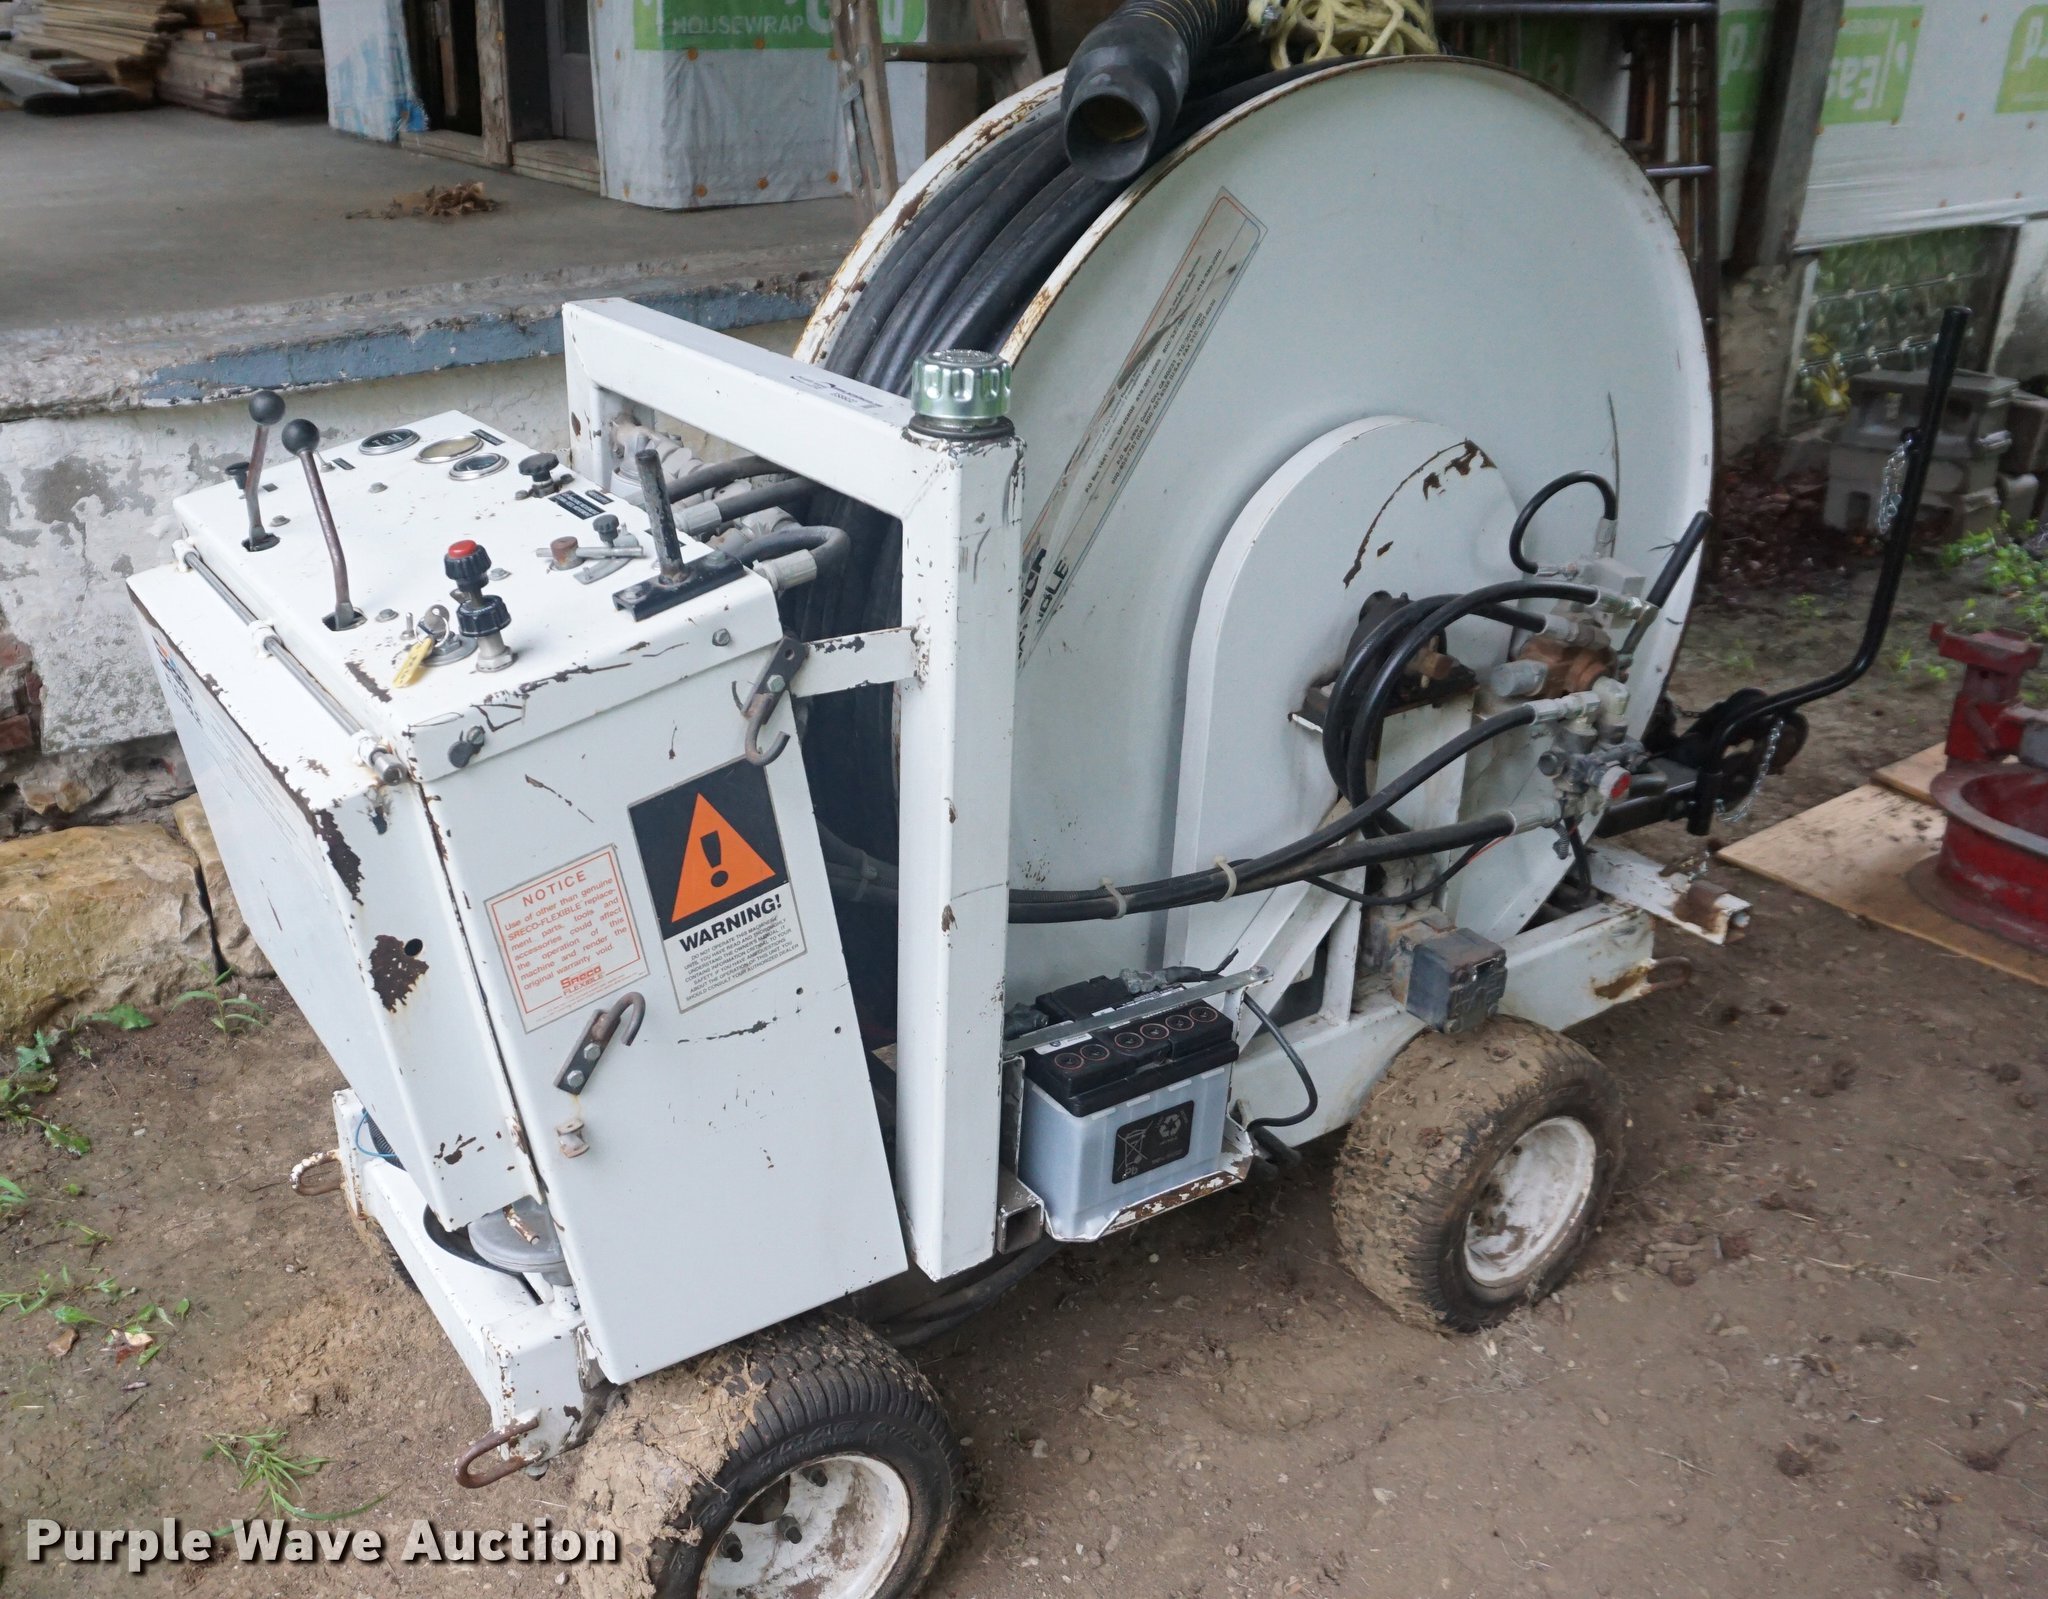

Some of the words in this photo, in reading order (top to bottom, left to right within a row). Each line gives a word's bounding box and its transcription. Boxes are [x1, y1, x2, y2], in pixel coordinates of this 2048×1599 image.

[671, 15, 804, 36] HOUSEWRAP
[504, 918, 521, 931] Use
[523, 913, 533, 922] of
[535, 902, 556, 916] other
[560, 892, 578, 905] than
[581, 877, 613, 897] genuine
[522, 869, 586, 907] NOTICE
[508, 901, 581, 941] SRECO-FLEXIBLE
[584, 887, 615, 907] replace-
[511, 936, 532, 951] ment
[573, 907, 594, 922] tools
[603, 896, 618, 908] and
[514, 934, 561, 961] accessories
[569, 919, 592, 935] could
[599, 906, 621, 921] affect
[680, 894, 783, 953] WARNING!
[517, 959, 530, 970] the
[541, 936, 579, 959] operation
[590, 927, 599, 936] of
[609, 915, 624, 927] this
[520, 960, 554, 980] machine
[561, 949, 576, 961] and
[582, 934, 608, 951] render
[614, 925, 627, 936] the
[685, 967, 710, 982] CONTAINS
[711, 951, 745, 970] INFORMATION
[747, 940, 768, 953] CRITICAL
[778, 928, 791, 937] YOUR
[688, 955, 722, 974] UNDERSTAND
[734, 939, 757, 953] OWNER'S
[700, 948, 710, 956] NOT
[712, 937, 734, 950] OPERATE
[736, 930, 747, 939] THIS
[701, 954, 711, 962] YOU
[712, 947, 725, 956] HAVE
[726, 940, 740, 950] READ
[742, 935, 752, 943] AND
[753, 918, 786, 937] THOROUGHLY
[732, 957, 745, 966] HAVE
[757, 938, 785, 954] QUESTIONS
[524, 972, 554, 991] original
[556, 954, 591, 975] warranty
[595, 942, 614, 956] void.
[562, 972, 604, 996] FLEXIBLE
[686, 988, 707, 1001] SHOULD
[708, 977, 730, 990] CONSULT
[733, 969, 746, 979] YOUR
[747, 953, 778, 971] AUTHORIZED
[779, 943, 798, 956] DEALER
[690, 981, 707, 993] ABOUT
[720, 962, 748, 979] OPERATION
